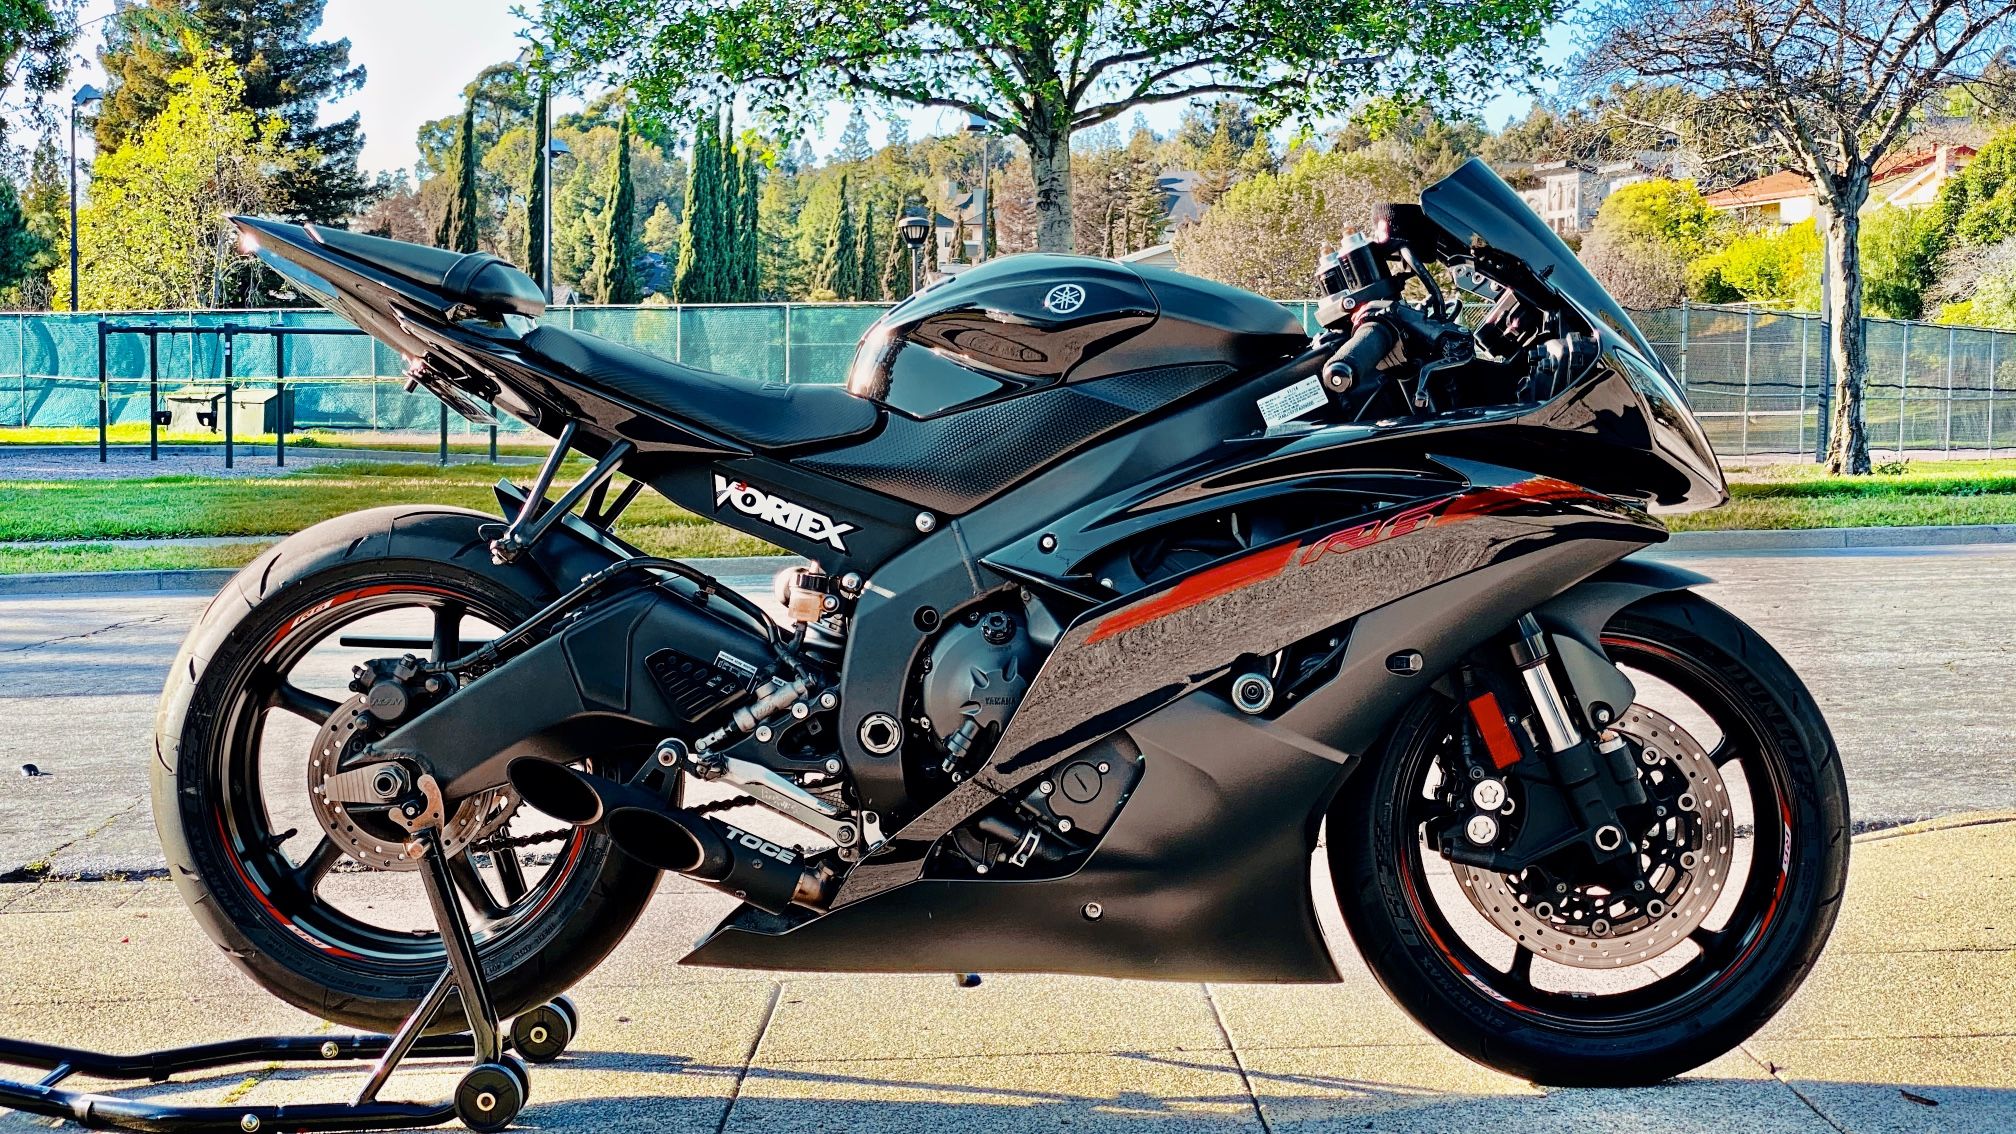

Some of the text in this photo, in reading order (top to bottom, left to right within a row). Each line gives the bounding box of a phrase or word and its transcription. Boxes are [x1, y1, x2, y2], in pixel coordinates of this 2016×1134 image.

[714, 473, 855, 552] VORTEX
[1300, 498, 1450, 566] R6
[725, 825, 797, 866] TOCE
